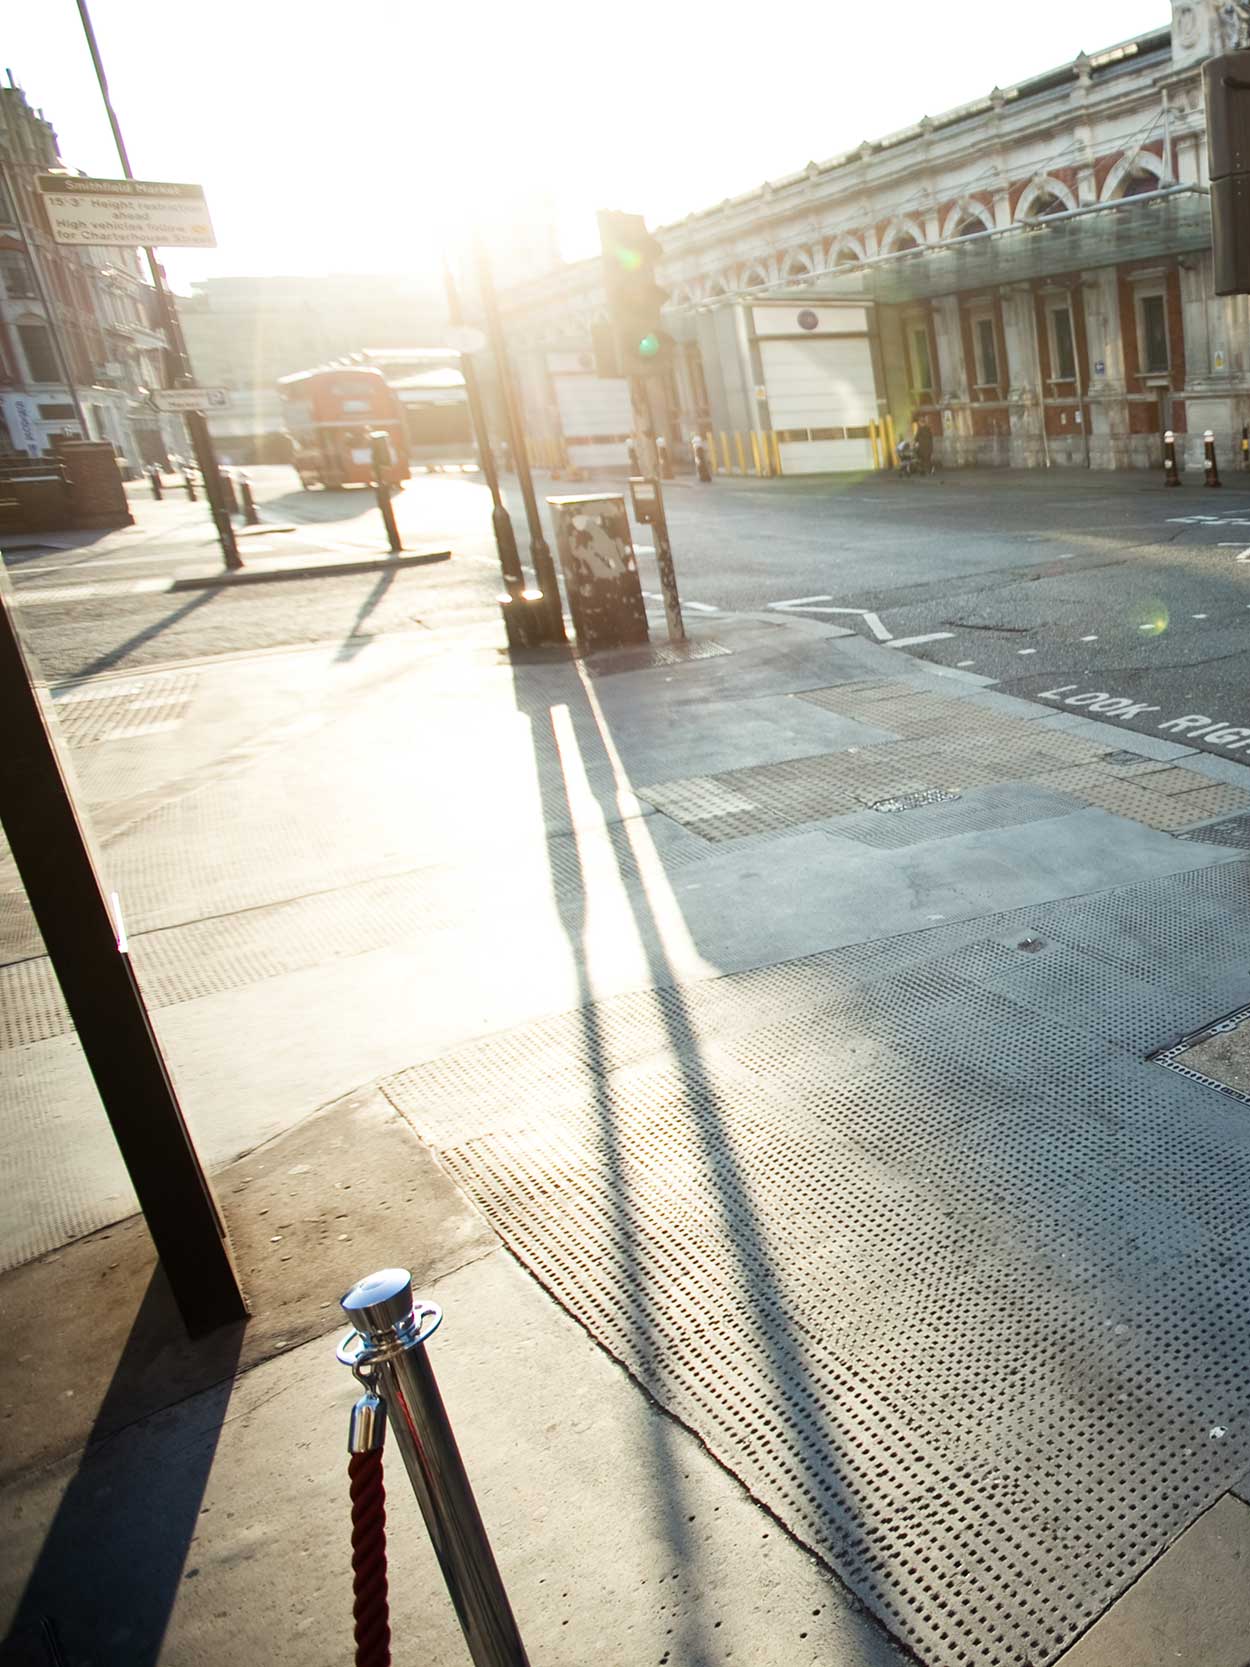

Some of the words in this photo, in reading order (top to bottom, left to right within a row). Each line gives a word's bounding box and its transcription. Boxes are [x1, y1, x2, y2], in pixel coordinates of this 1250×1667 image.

[64, 179, 129, 194] Smithfield
[56, 219, 87, 231] High
[1037, 684, 1161, 720] LOOK
